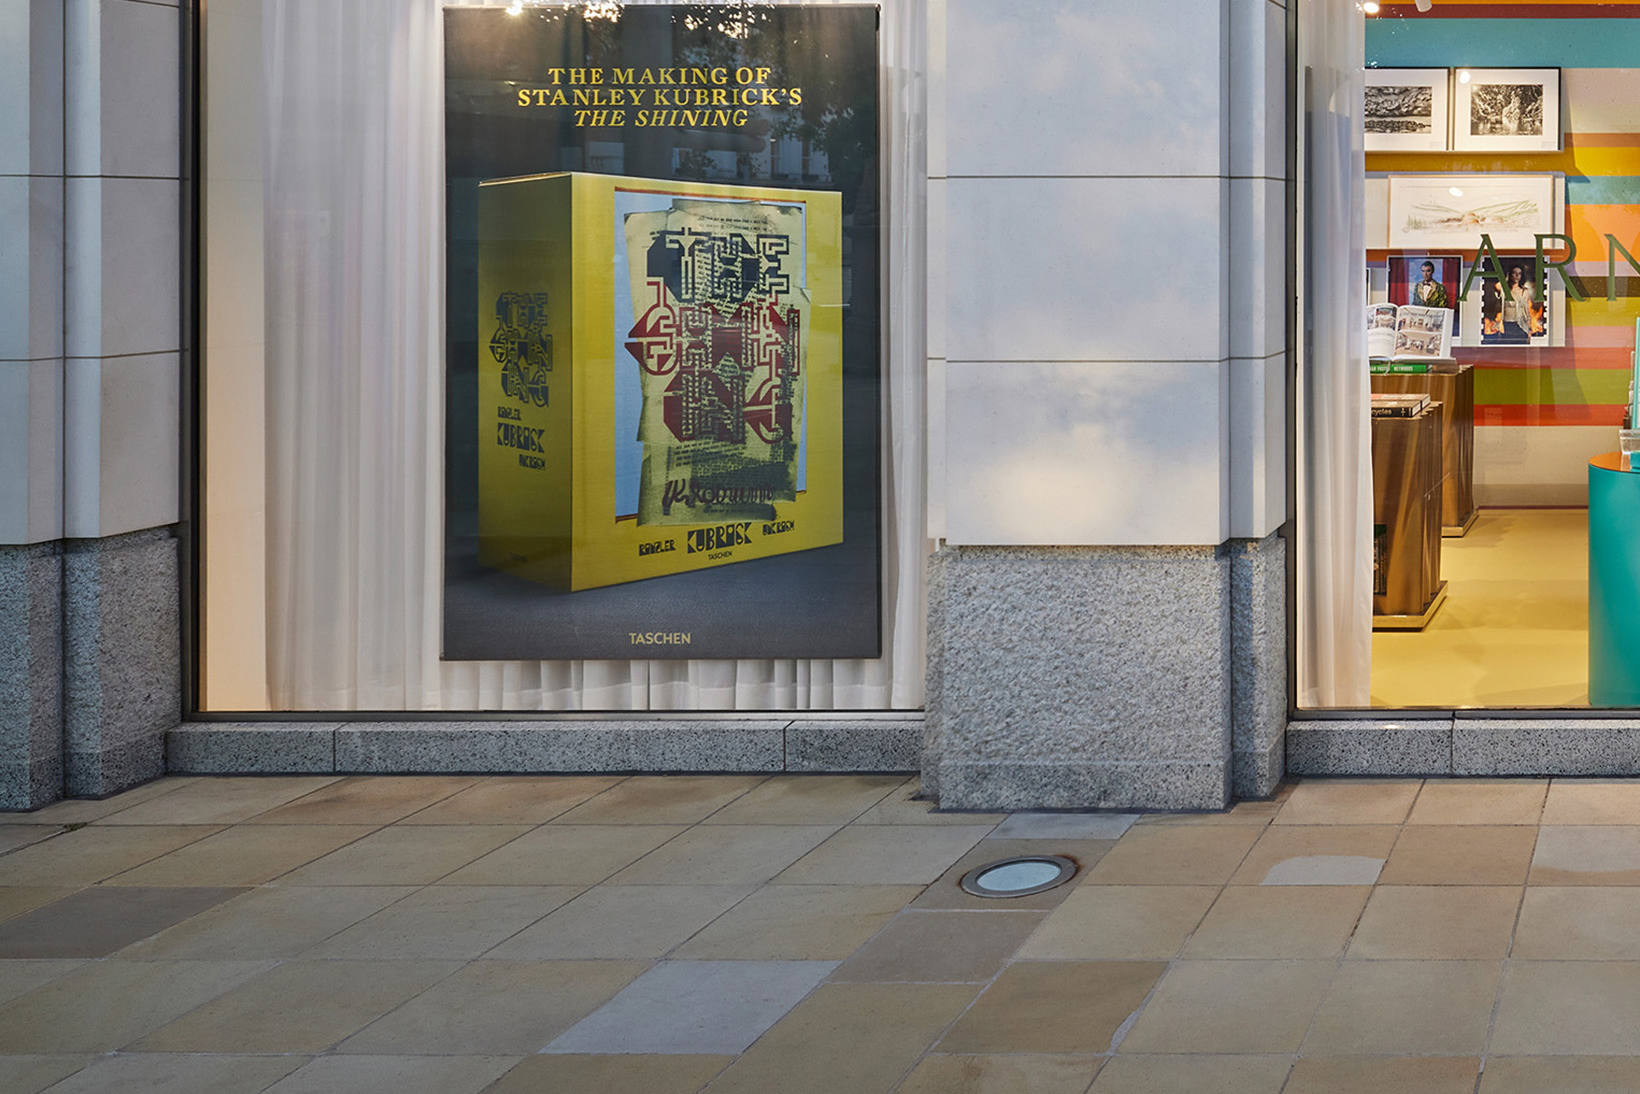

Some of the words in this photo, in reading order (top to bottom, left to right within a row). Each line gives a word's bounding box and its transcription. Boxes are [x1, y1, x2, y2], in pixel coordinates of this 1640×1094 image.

[548, 67, 603, 86] THE
[612, 67, 728, 86] MAKING
[735, 67, 772, 85] OF
[517, 89, 645, 107] STANLEY
[653, 88, 802, 107] KUBRICK'S
[574, 109, 626, 127] THE
[635, 109, 749, 127] SHINING
[708, 550, 733, 561] TASCHEN
[629, 631, 691, 645] TASCHEN
